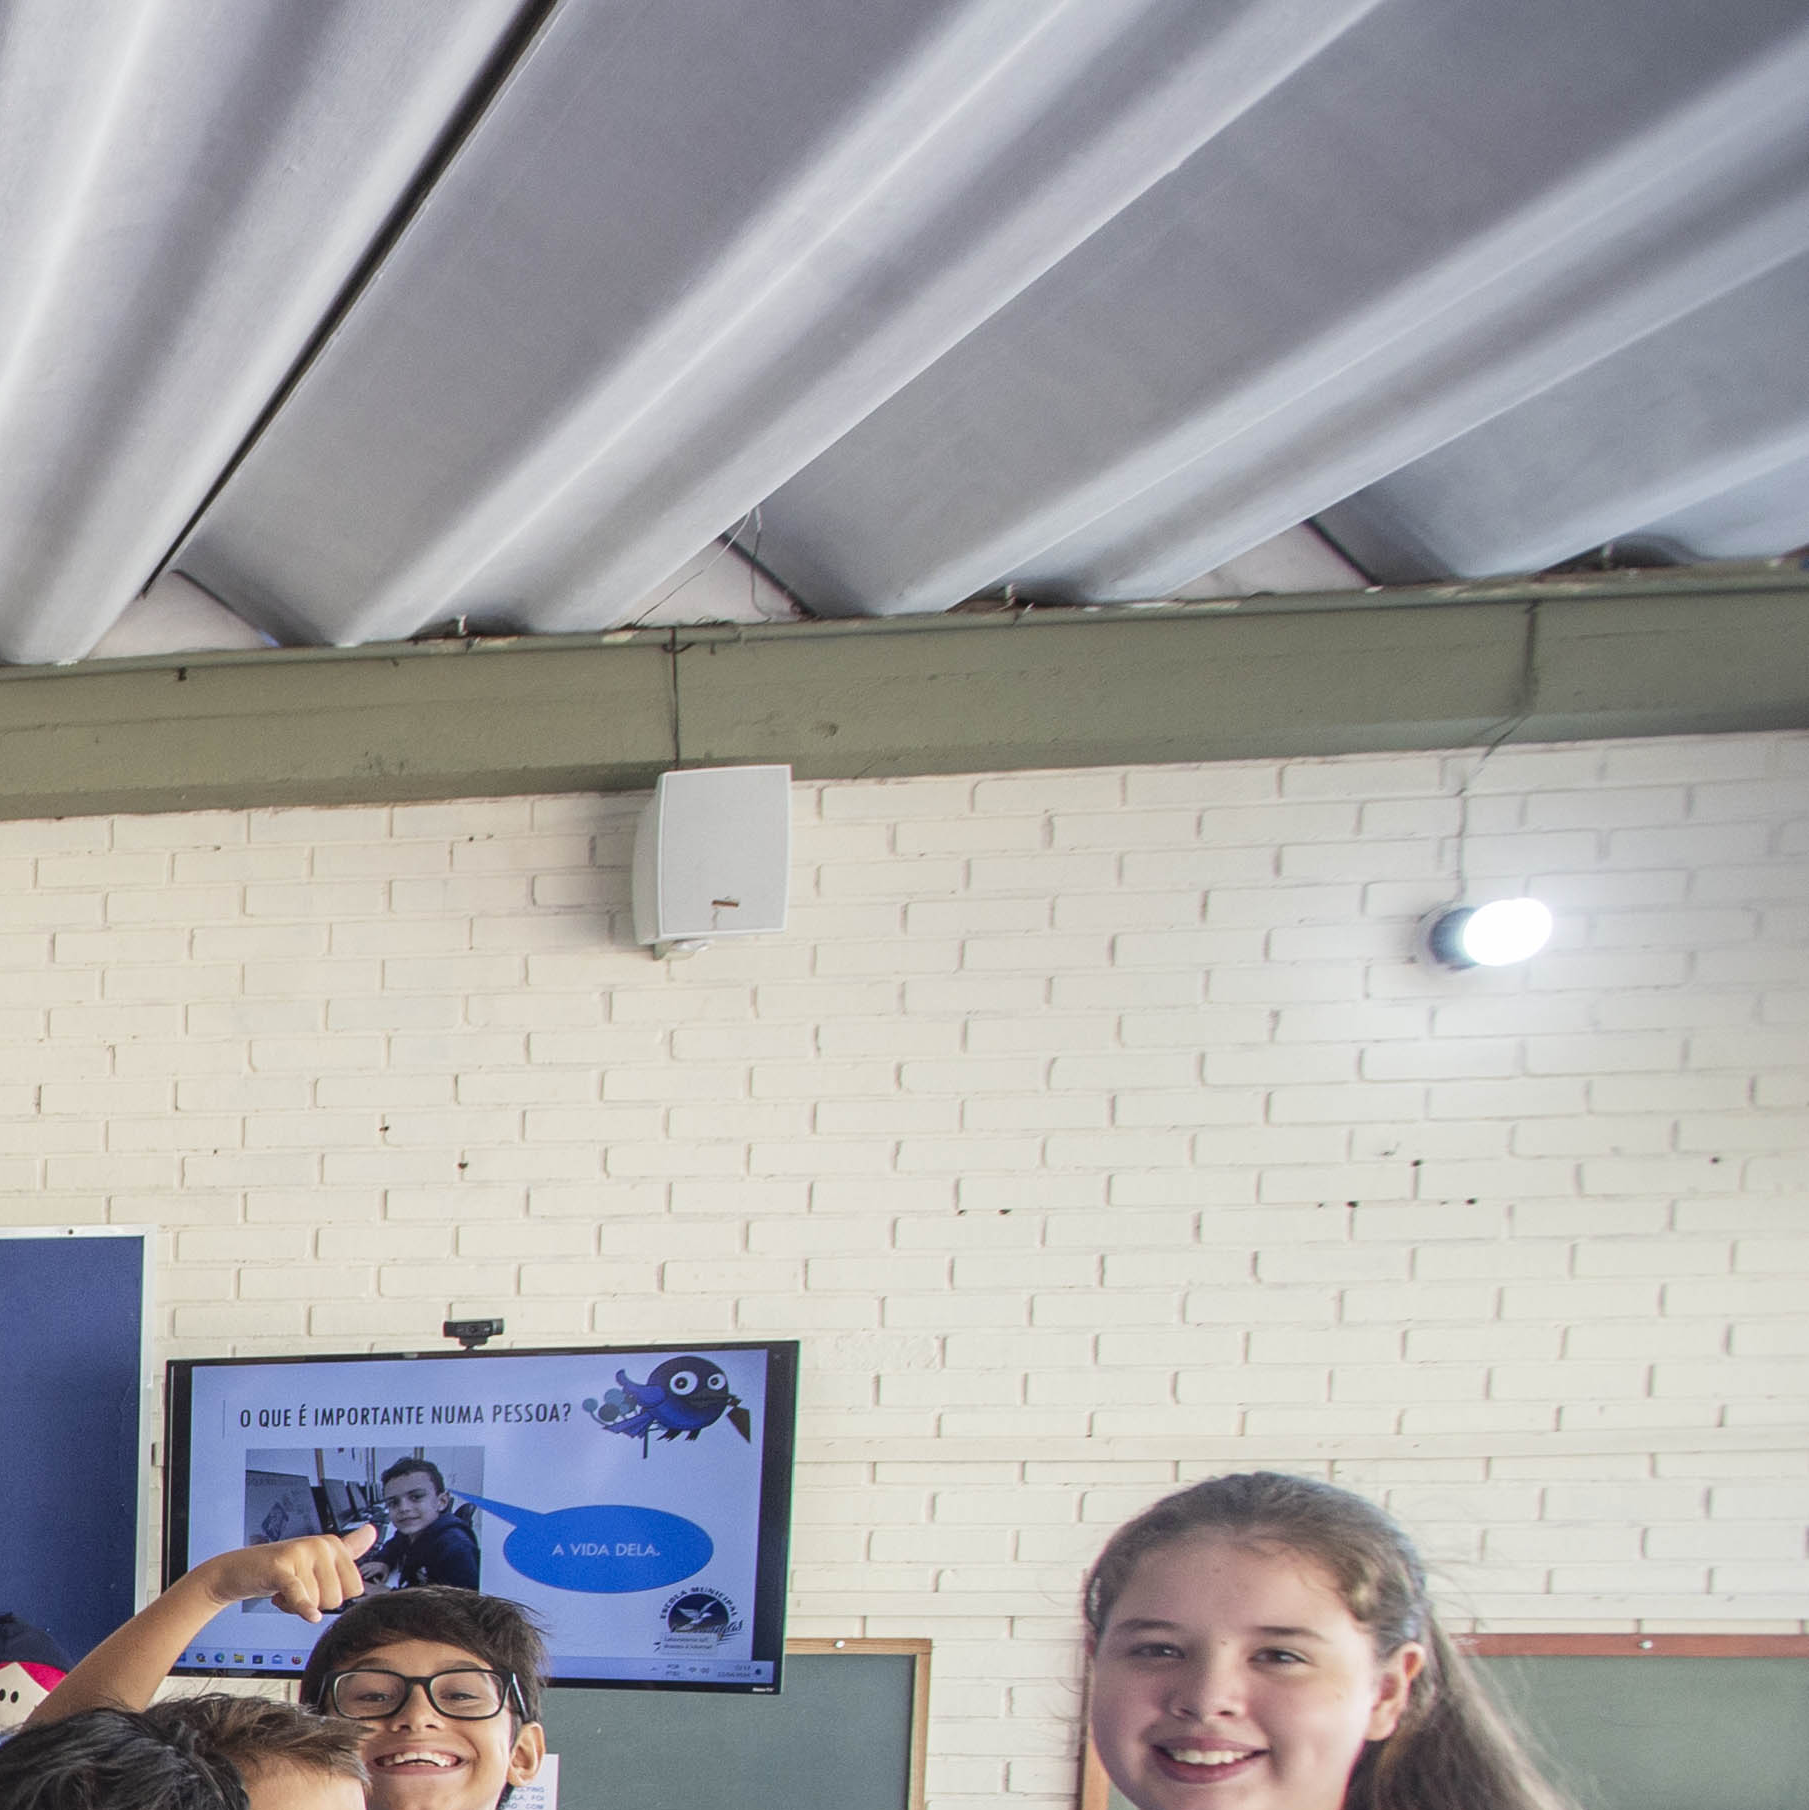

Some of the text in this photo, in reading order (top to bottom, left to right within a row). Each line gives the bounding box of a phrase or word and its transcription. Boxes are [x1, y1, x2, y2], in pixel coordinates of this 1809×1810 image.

[240, 1402, 573, 1429] O QUE É IMPORTANTE NUMA PESSOA?
[552, 1543, 661, 1557] A VIDA DELA.
